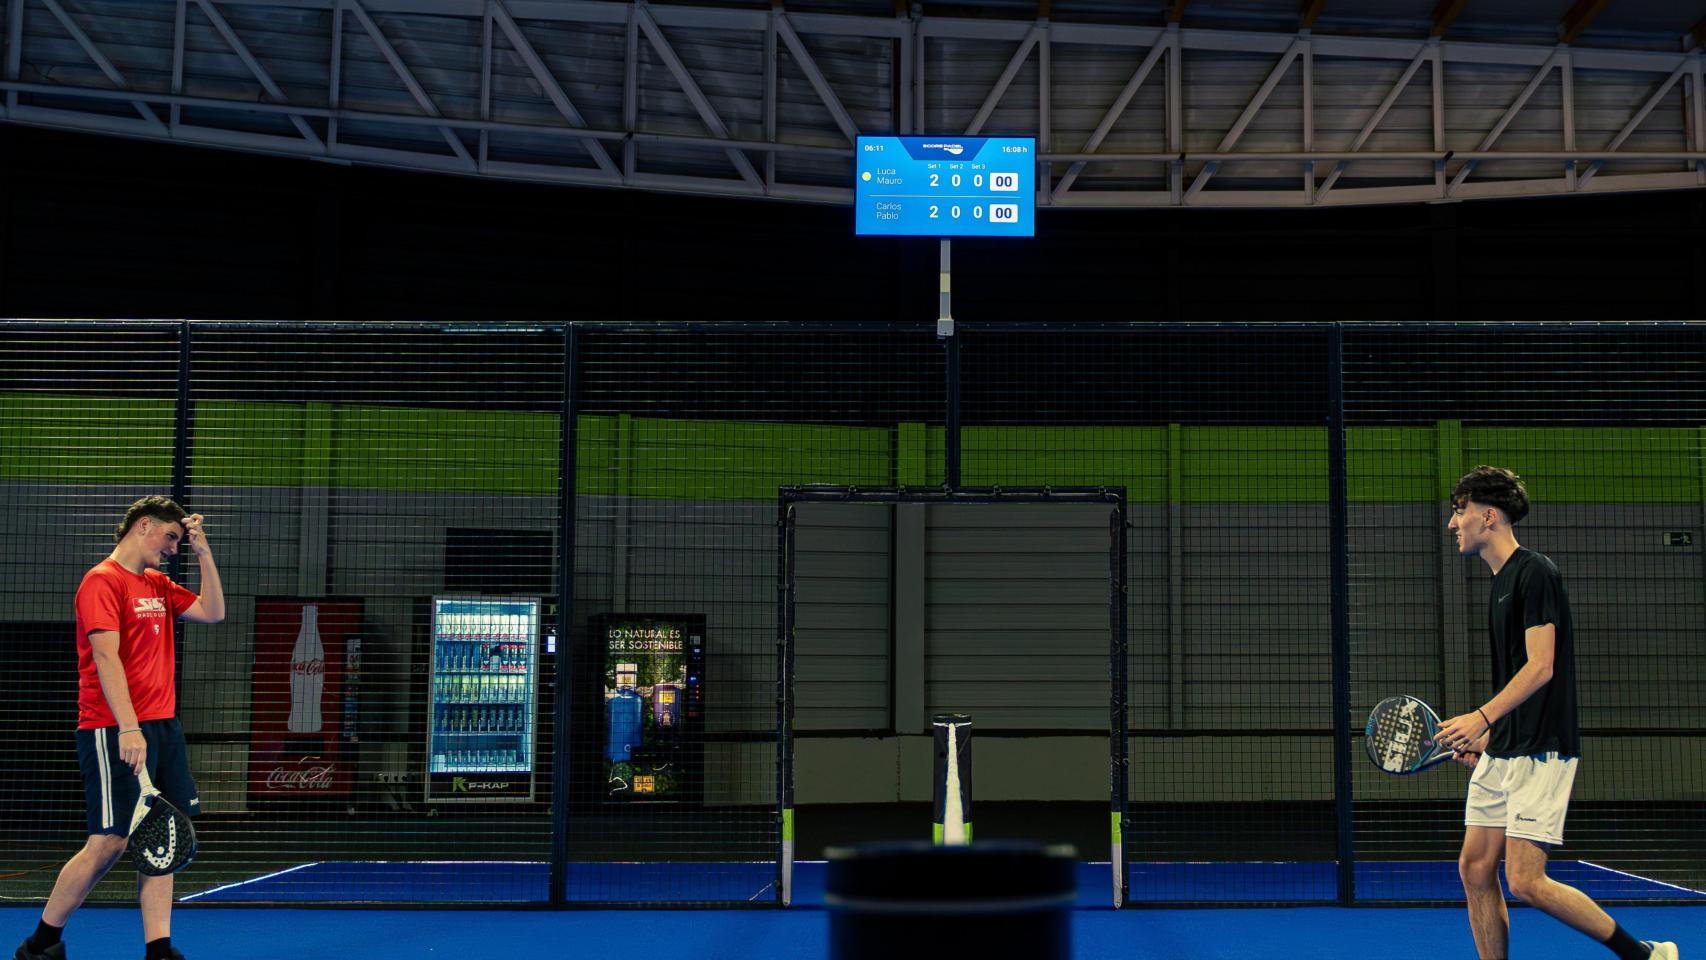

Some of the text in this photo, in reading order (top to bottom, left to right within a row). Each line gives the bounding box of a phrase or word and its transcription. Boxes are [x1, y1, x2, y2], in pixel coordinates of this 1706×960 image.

[877, 167, 896, 175] Luca
[876, 177, 903, 185] Mauro
[929, 174, 1013, 187] 2 0 0 00
[876, 202, 902, 211] Carlos
[876, 211, 899, 220] Pablo
[929, 205, 1012, 219] 2 0 0 00
[609, 629, 681, 639] LO NATURAL ES
[608, 640, 684, 650] SER SOSTENIBLE
